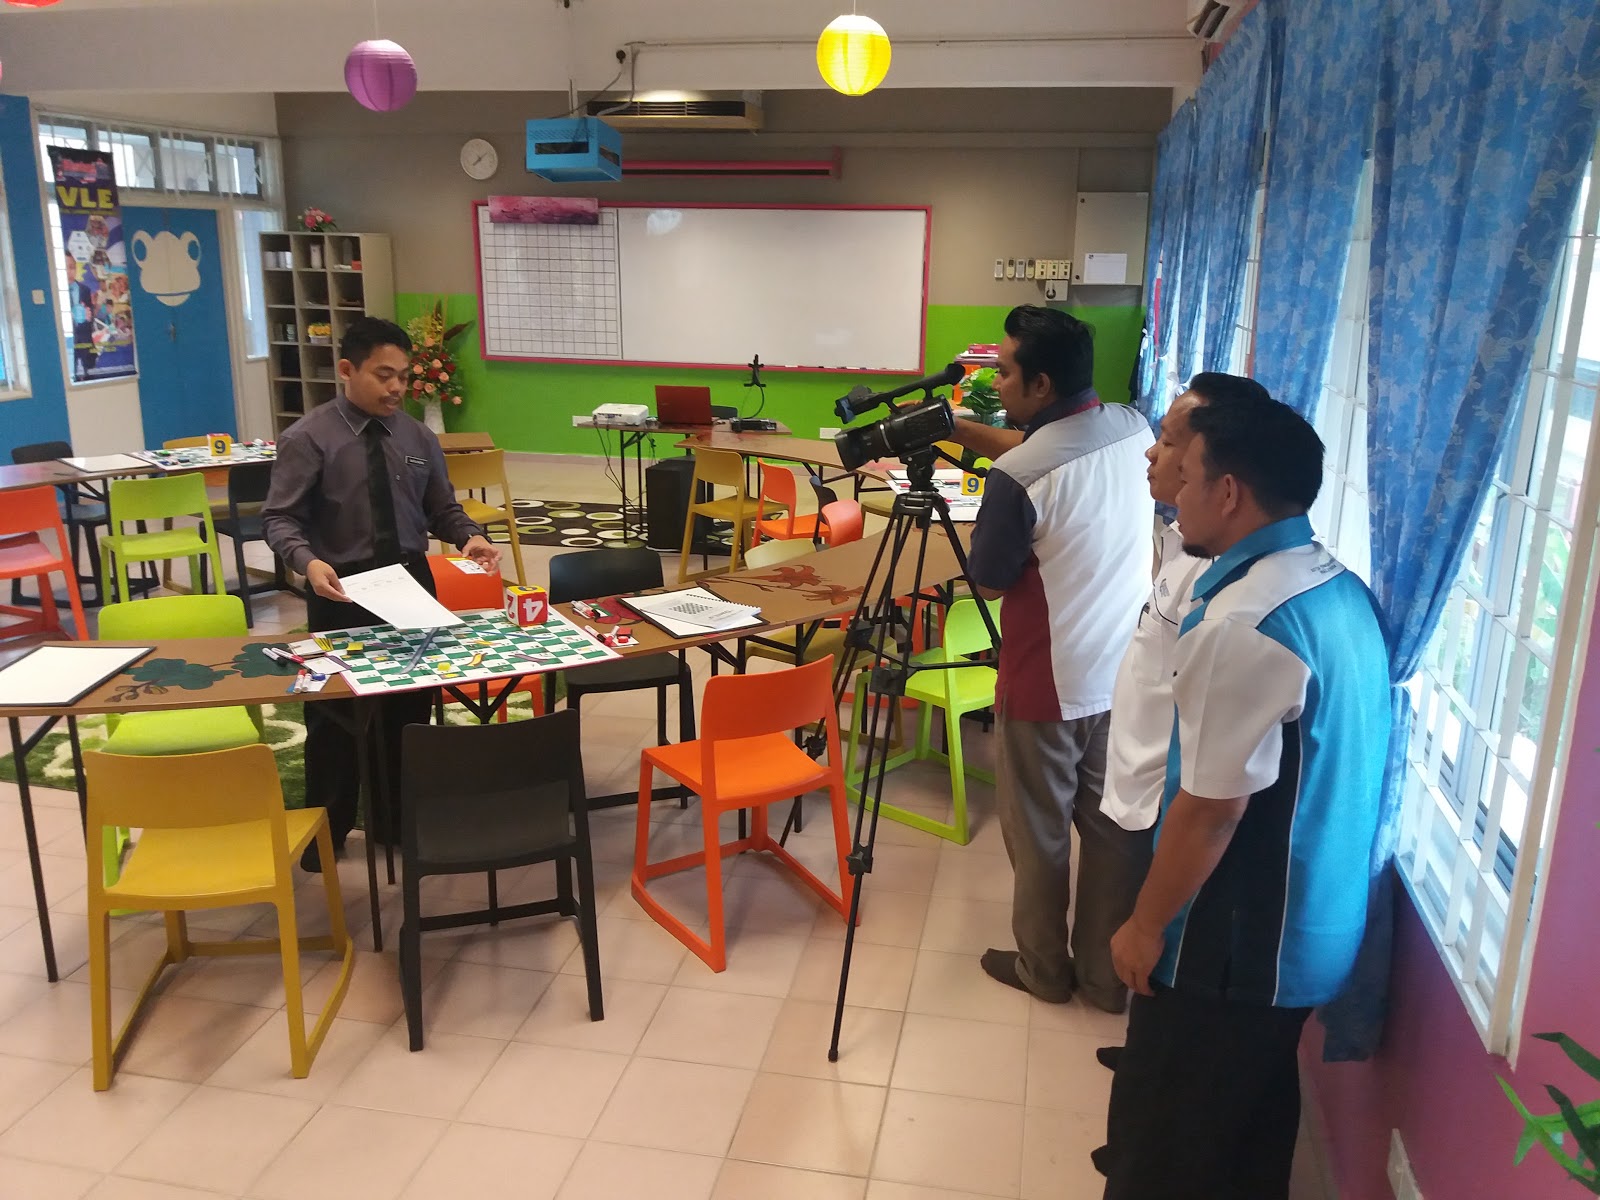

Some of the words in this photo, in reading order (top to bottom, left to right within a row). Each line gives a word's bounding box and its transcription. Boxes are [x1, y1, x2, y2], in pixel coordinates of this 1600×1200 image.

[57, 186, 114, 209] VLE
[214, 439, 226, 454] 9
[967, 477, 980, 493] 9
[522, 598, 544, 622] 4
